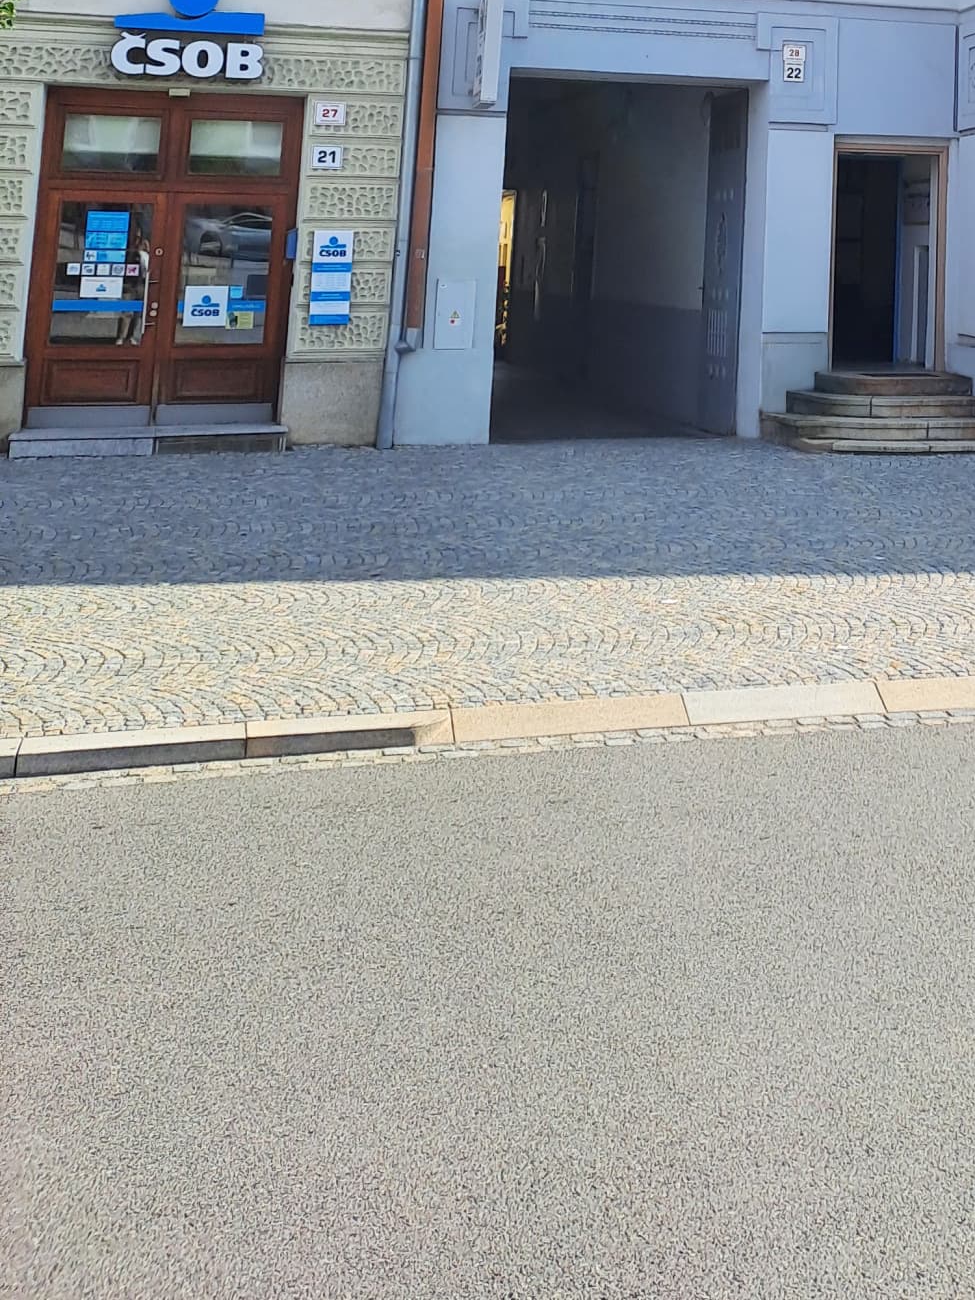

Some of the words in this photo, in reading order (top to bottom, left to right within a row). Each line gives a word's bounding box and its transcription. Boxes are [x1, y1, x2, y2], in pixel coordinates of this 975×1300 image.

[110, 31, 264, 79] ČSOB
[788, 49, 800, 57] 28
[786, 67, 802, 79] 22
[322, 108, 338, 118] 27
[317, 150, 336, 164] 21
